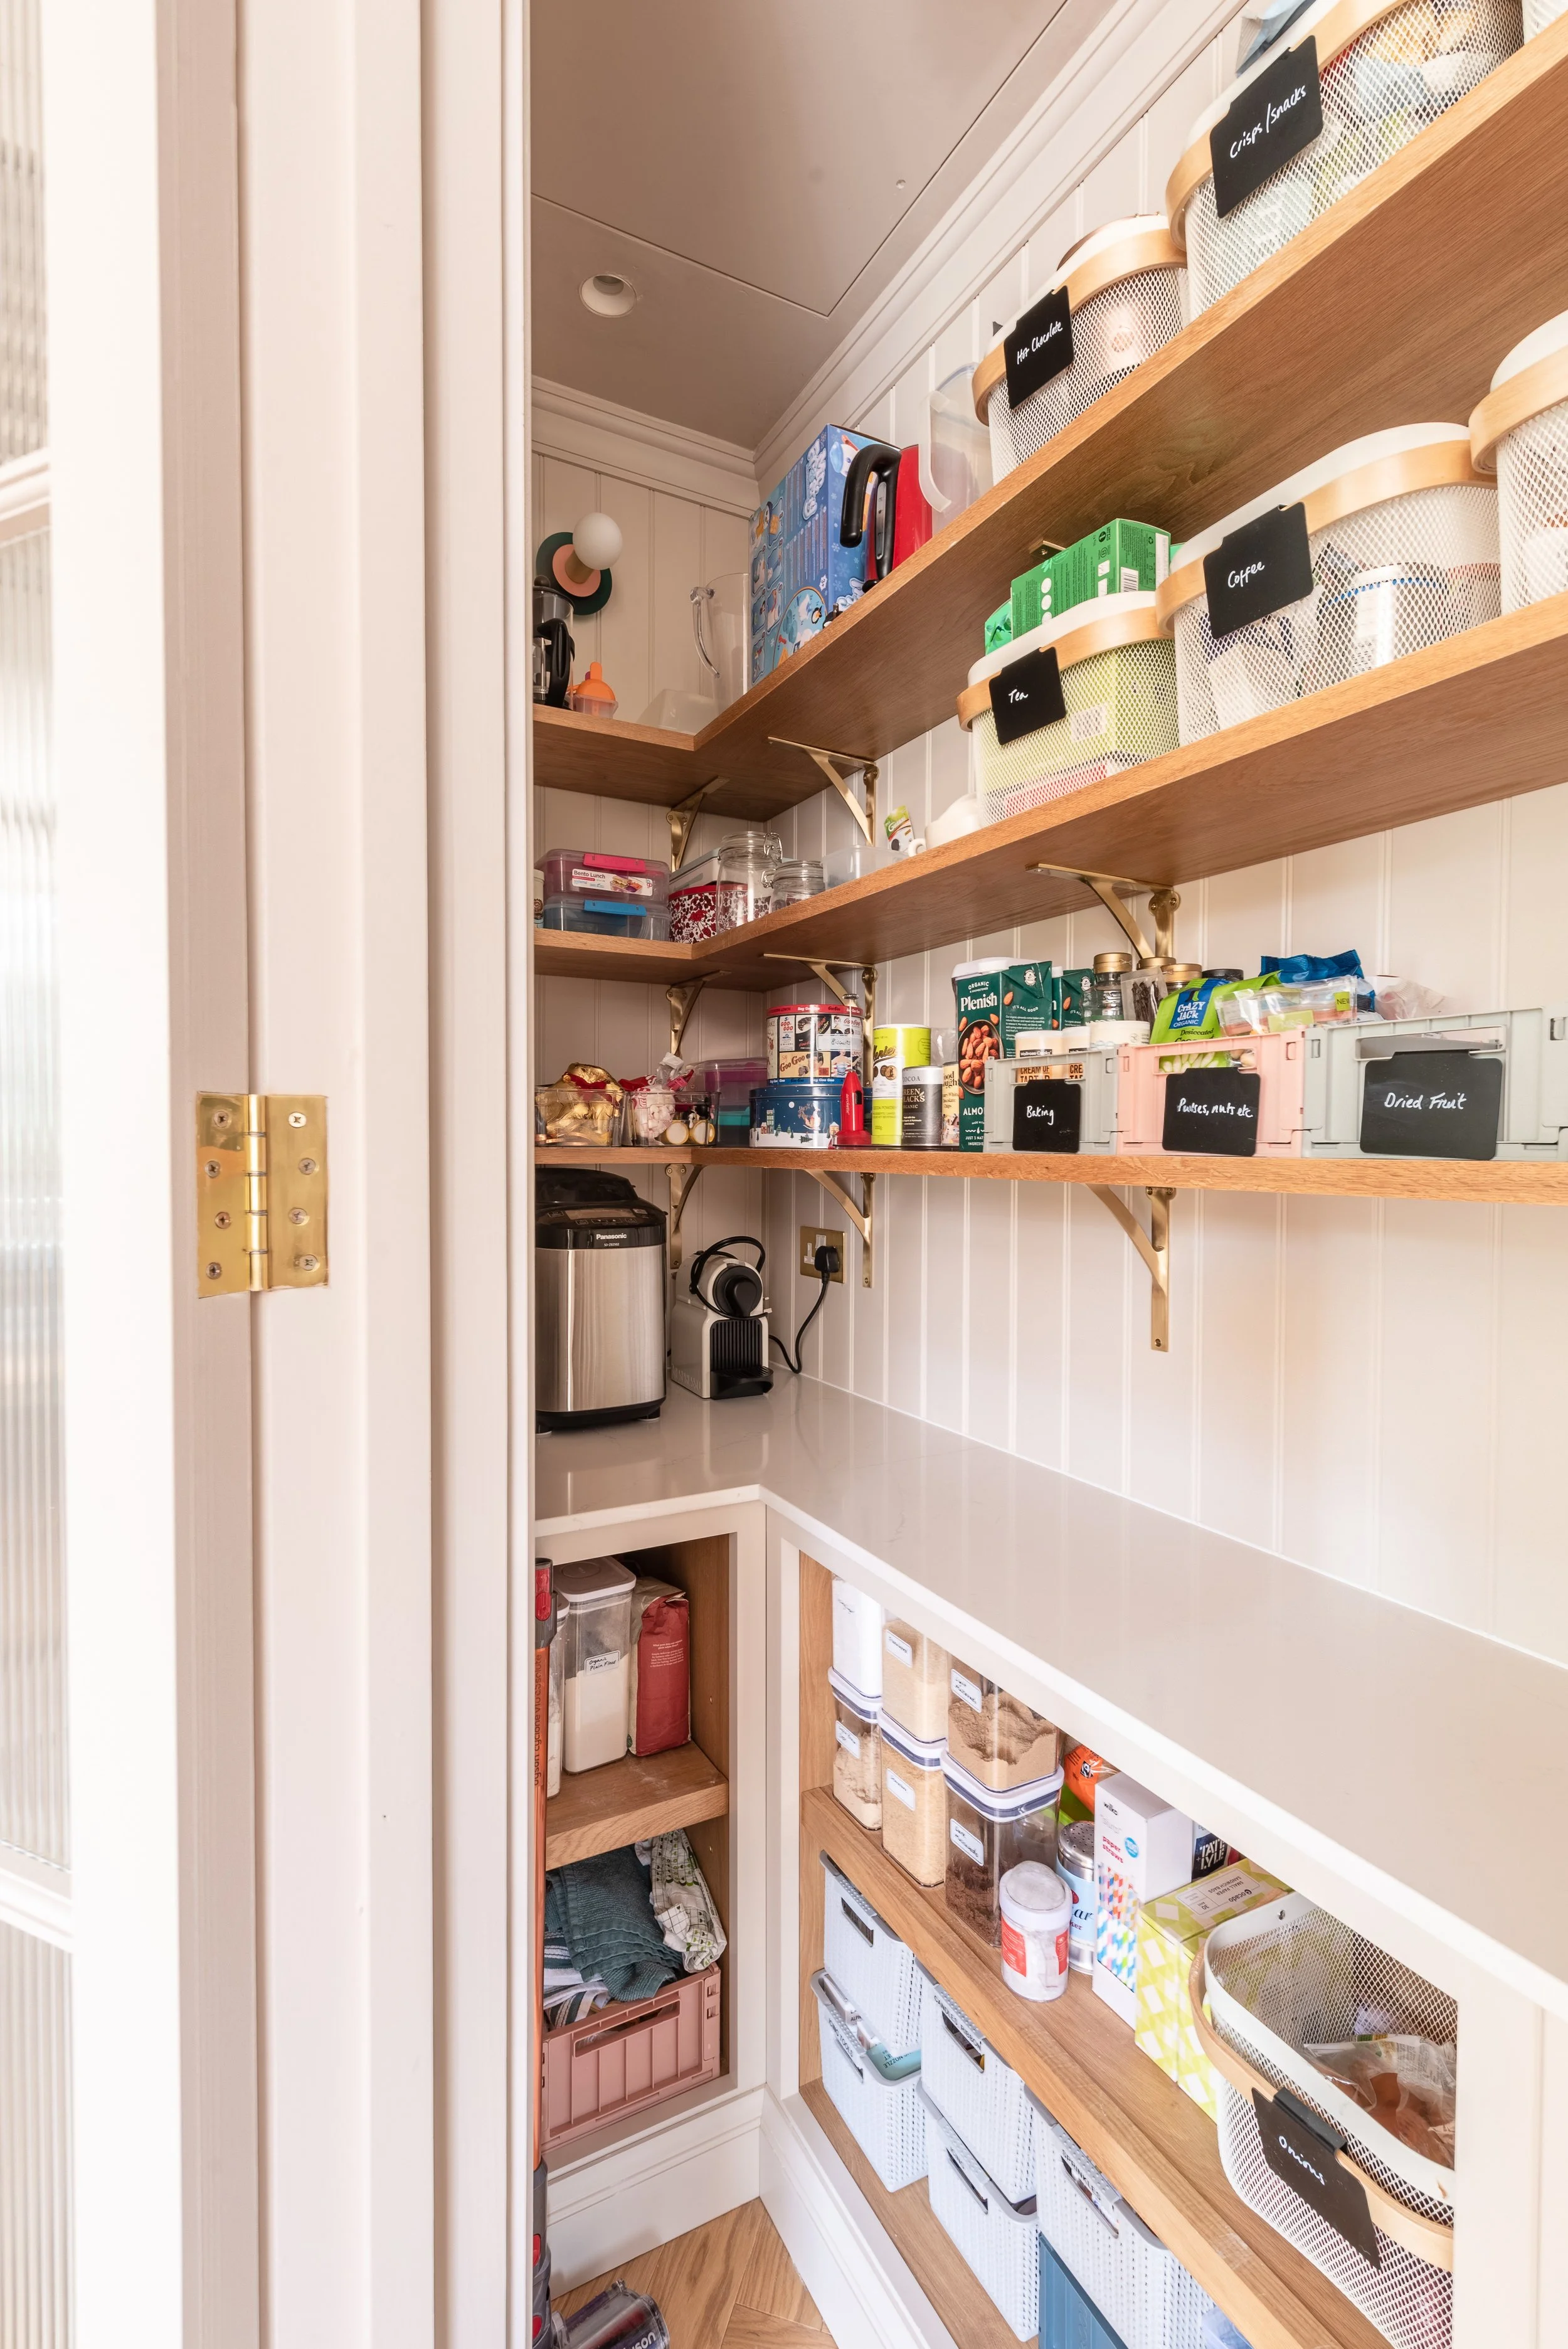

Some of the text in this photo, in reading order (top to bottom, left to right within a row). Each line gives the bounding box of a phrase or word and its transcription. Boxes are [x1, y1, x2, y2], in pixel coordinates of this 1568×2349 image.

[1017, 321, 1063, 365] Hot Chocolate
[1227, 561, 1265, 588] Coffee
[1008, 688, 1029, 704] Tea
[968, 981, 990, 990] ORGANIC
[960, 992, 997, 1012] Plenish
[1173, 1019, 1199, 1027] ORGANIC
[1180, 1028, 1214, 1036] Desiccated
[780, 1055, 805, 1072] Goo Goo
[1020, 1066, 1041, 1074] CREAM
[1069, 1064, 1083, 1074] CRE
[903, 1088, 921, 1096] REEN
[1384, 1092, 1467, 1110] Dried Fruit
[963, 1106, 984, 1116] ALMO
[1026, 1105, 1054, 1126] Baking
[1210, 1102, 1236, 1115] nuts
[1236, 1104, 1254, 1118] etc
[589, 1657, 607, 1665] Organic
[590, 1663, 603, 1671] Plain
[1103, 1835, 1121, 1853] paper
[1102, 1844, 1124, 1864] straws
[1216, 1880, 1244, 1896] SMALL PAPER
[1219, 1875, 1242, 1888] SANDWICH
[934, 1995, 958, 2026] CANDLES
[882, 2055, 904, 2069] NOZZLE
[1278, 2135, 1325, 2186] Onions
[1061, 2148, 1102, 2202] SPRINKLES
